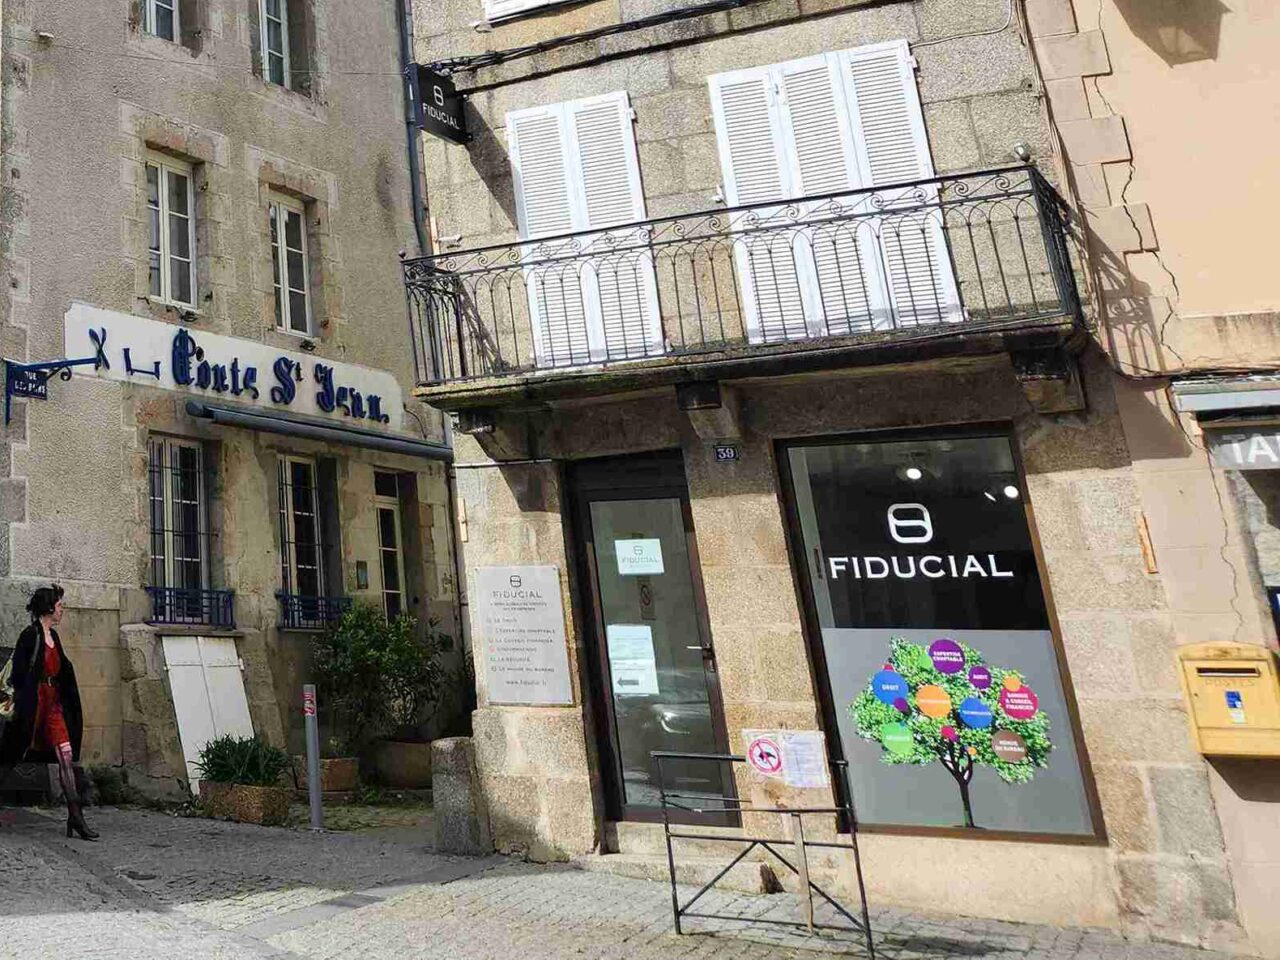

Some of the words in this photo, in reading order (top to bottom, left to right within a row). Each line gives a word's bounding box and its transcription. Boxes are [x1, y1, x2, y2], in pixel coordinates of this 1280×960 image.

[422, 102, 460, 130] FIDUCIAL
[314, 362, 390, 424] Jean
[717, 447, 734, 459] 39
[1222, 433, 1280, 464] TA
[622, 556, 659, 565] FIDUCIAL
[828, 554, 1014, 579] FIDUCIAL
[492, 590, 543, 599] FIDUCIAL
